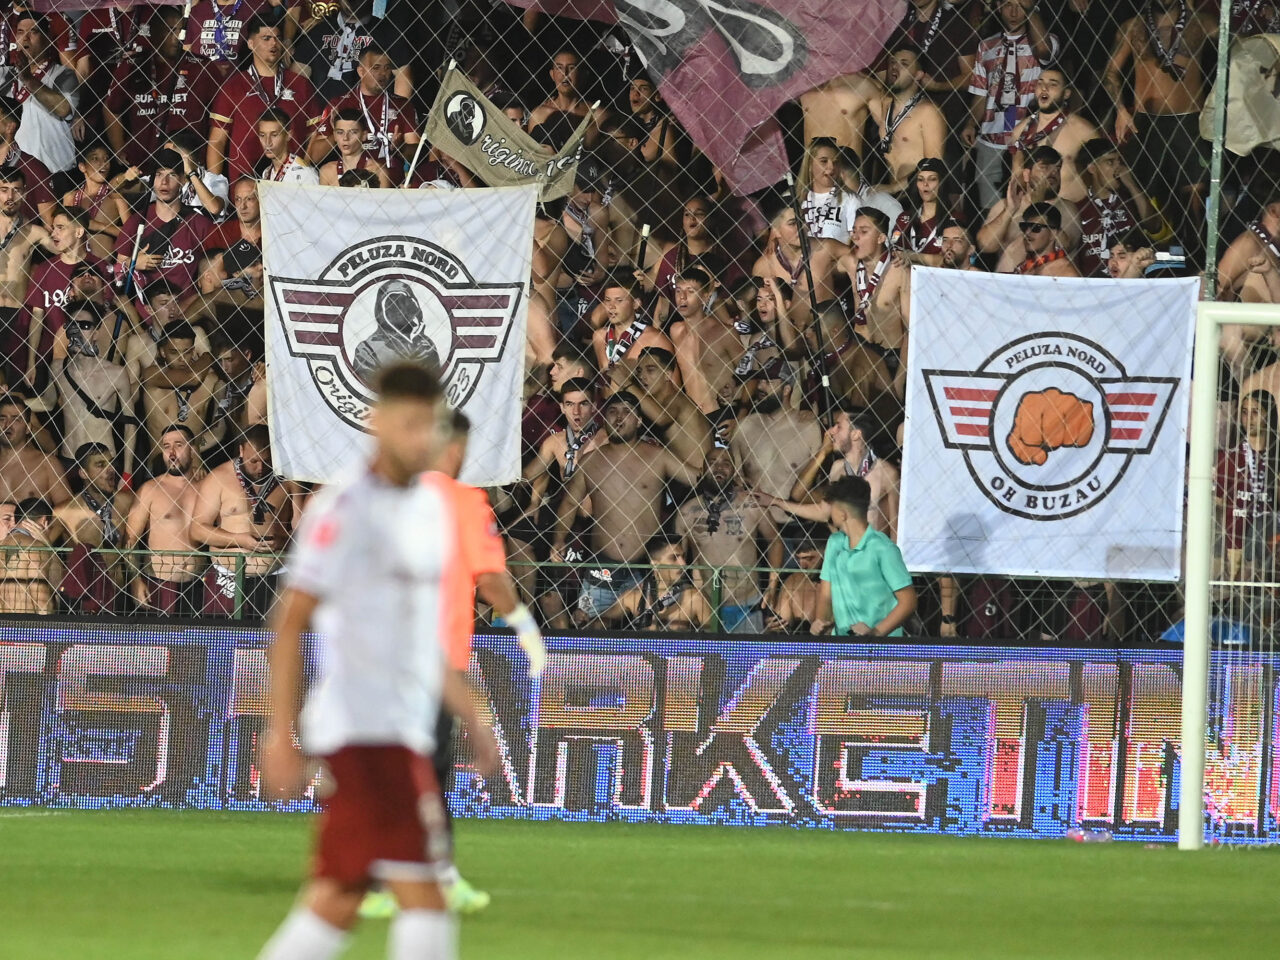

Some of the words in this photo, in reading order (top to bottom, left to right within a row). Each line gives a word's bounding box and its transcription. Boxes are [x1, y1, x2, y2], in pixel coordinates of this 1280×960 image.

[337, 244, 406, 279] PELUZA
[410, 248, 459, 280] NORD
[1004, 344, 1063, 370] PELUZA
[1066, 346, 1107, 375] NORD
[990, 475, 1017, 503] OH
[1023, 475, 1103, 511] BUZAU
